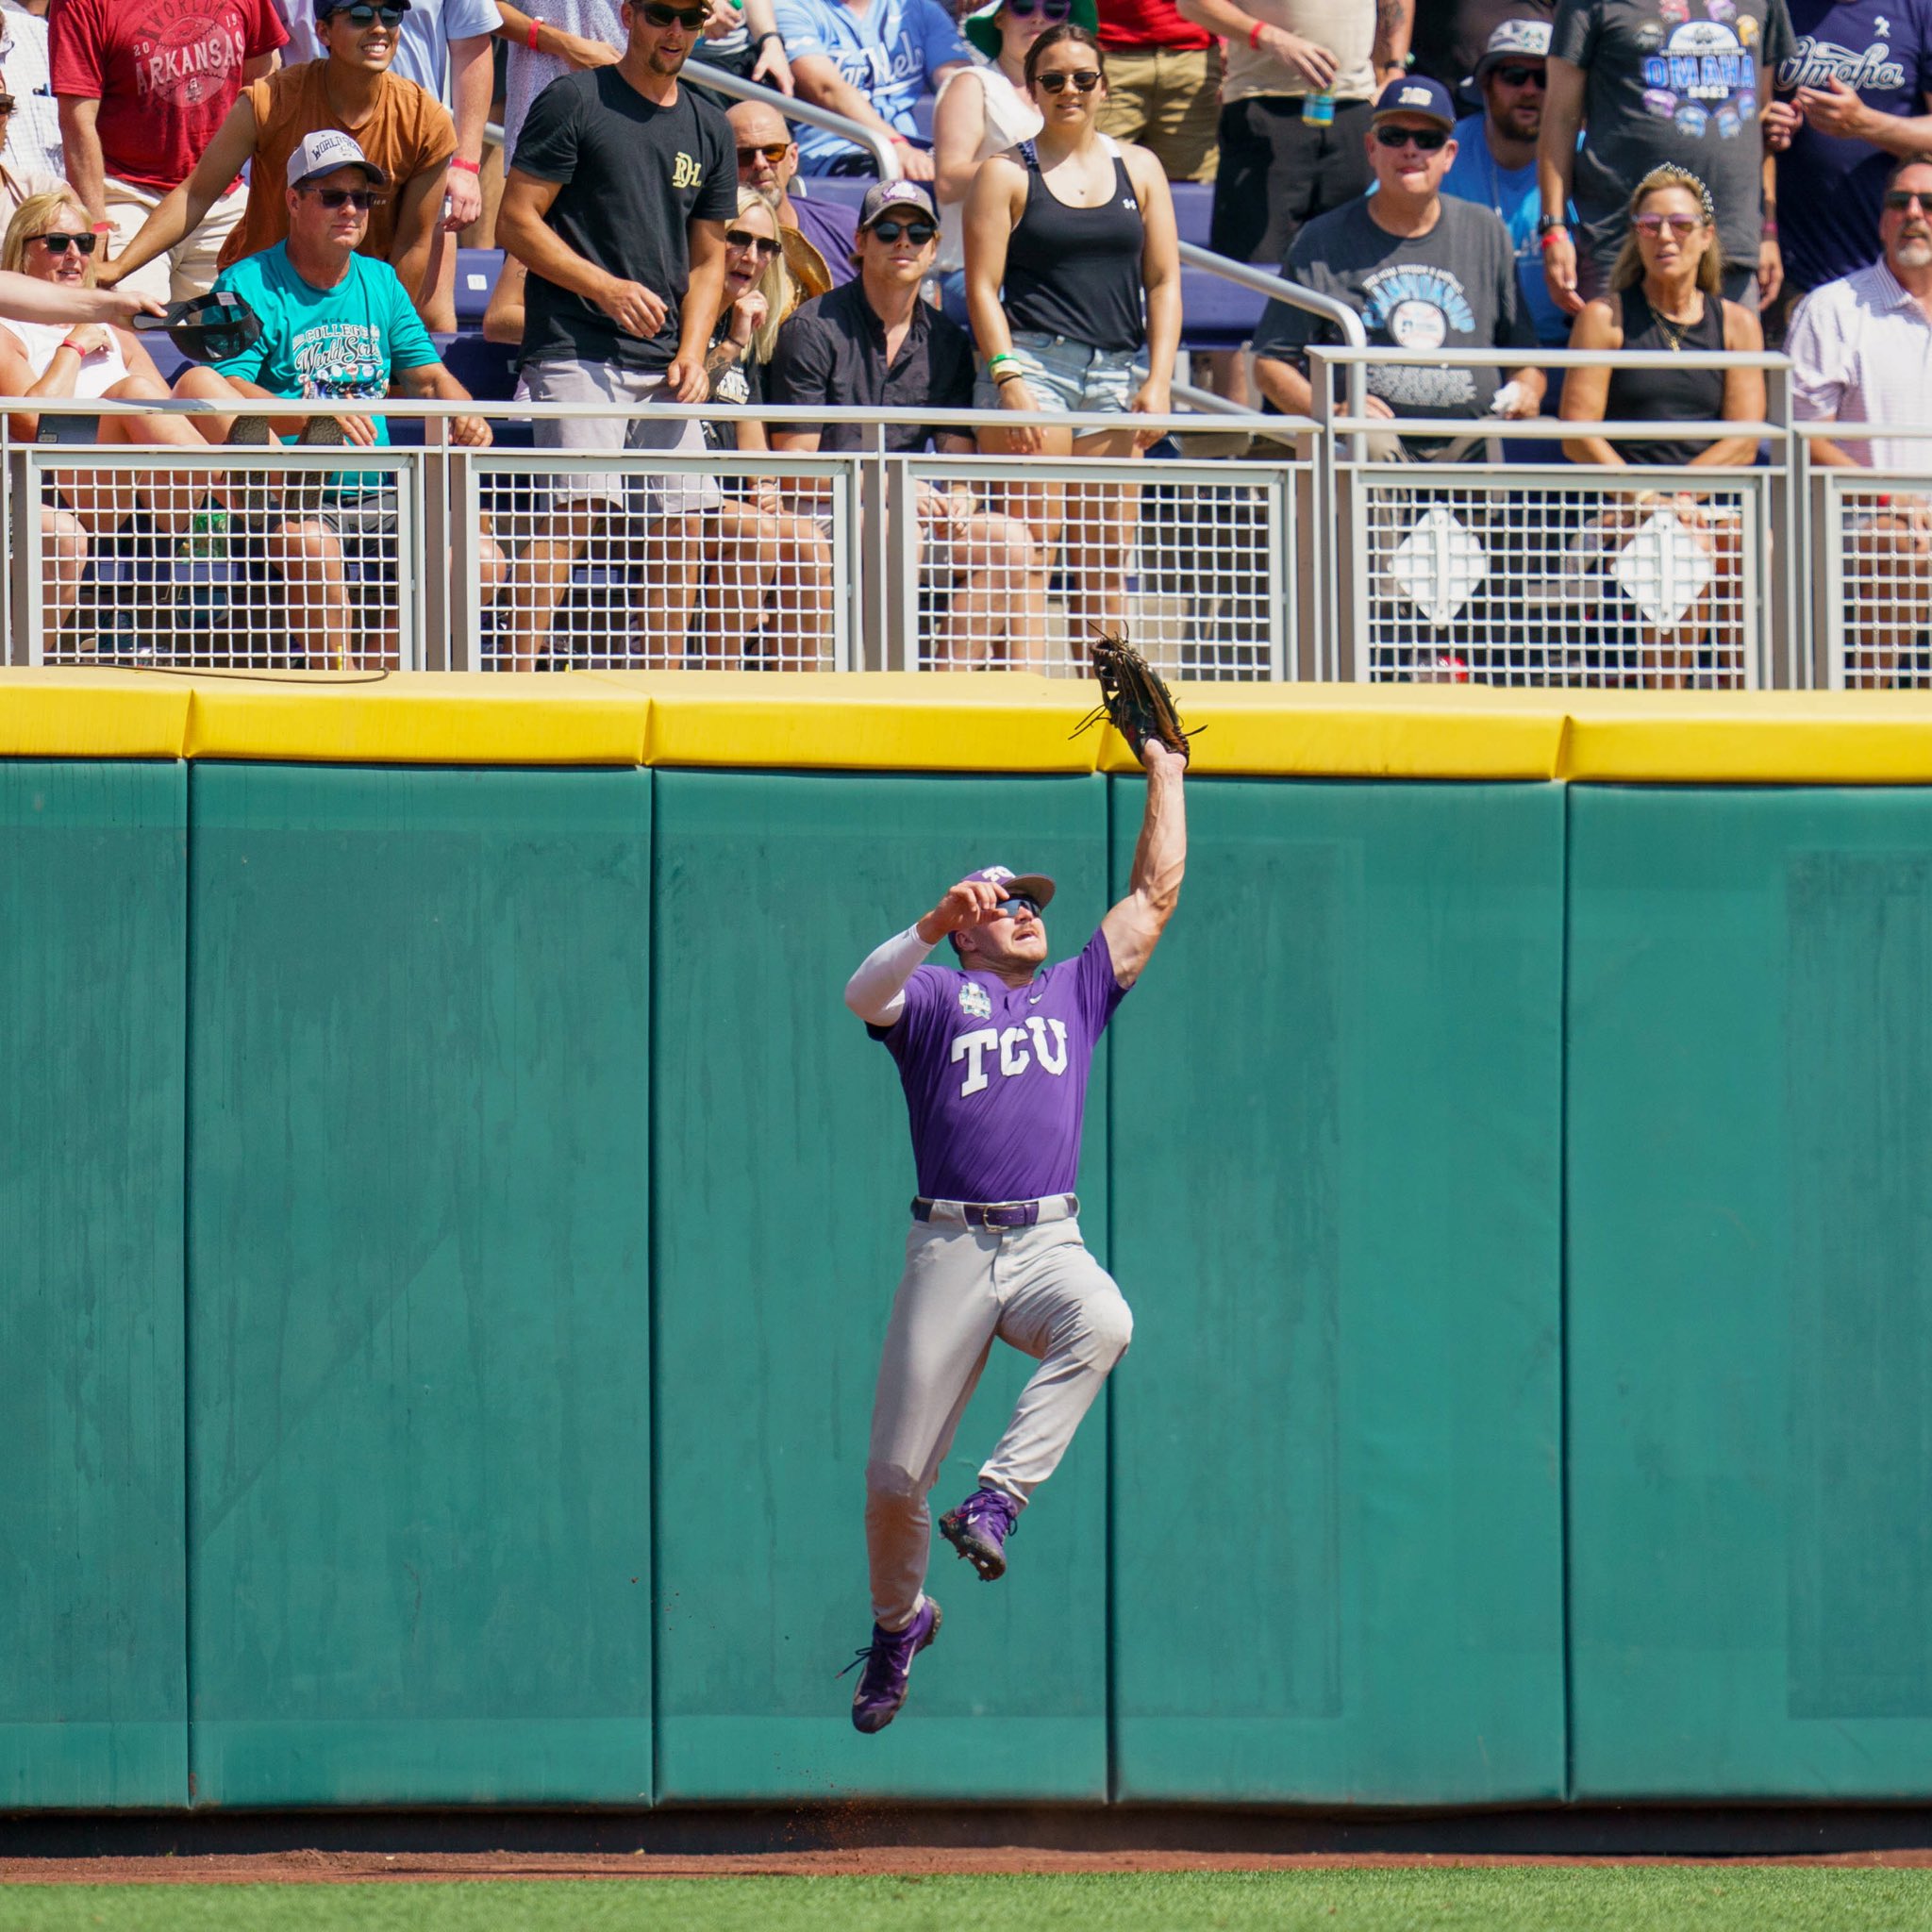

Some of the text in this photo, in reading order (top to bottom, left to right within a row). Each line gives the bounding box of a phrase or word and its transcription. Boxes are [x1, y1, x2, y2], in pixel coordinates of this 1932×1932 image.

[133, 42, 150, 57] 20
[135, 30, 244, 95] ARKANSAS
[1774, 35, 1906, 92] Omaha
[1644, 54, 1755, 90] OMAHA
[311, 135, 343, 161] WORLD
[294, 338, 345, 375] World
[951, 1015, 1068, 1098] TCU
